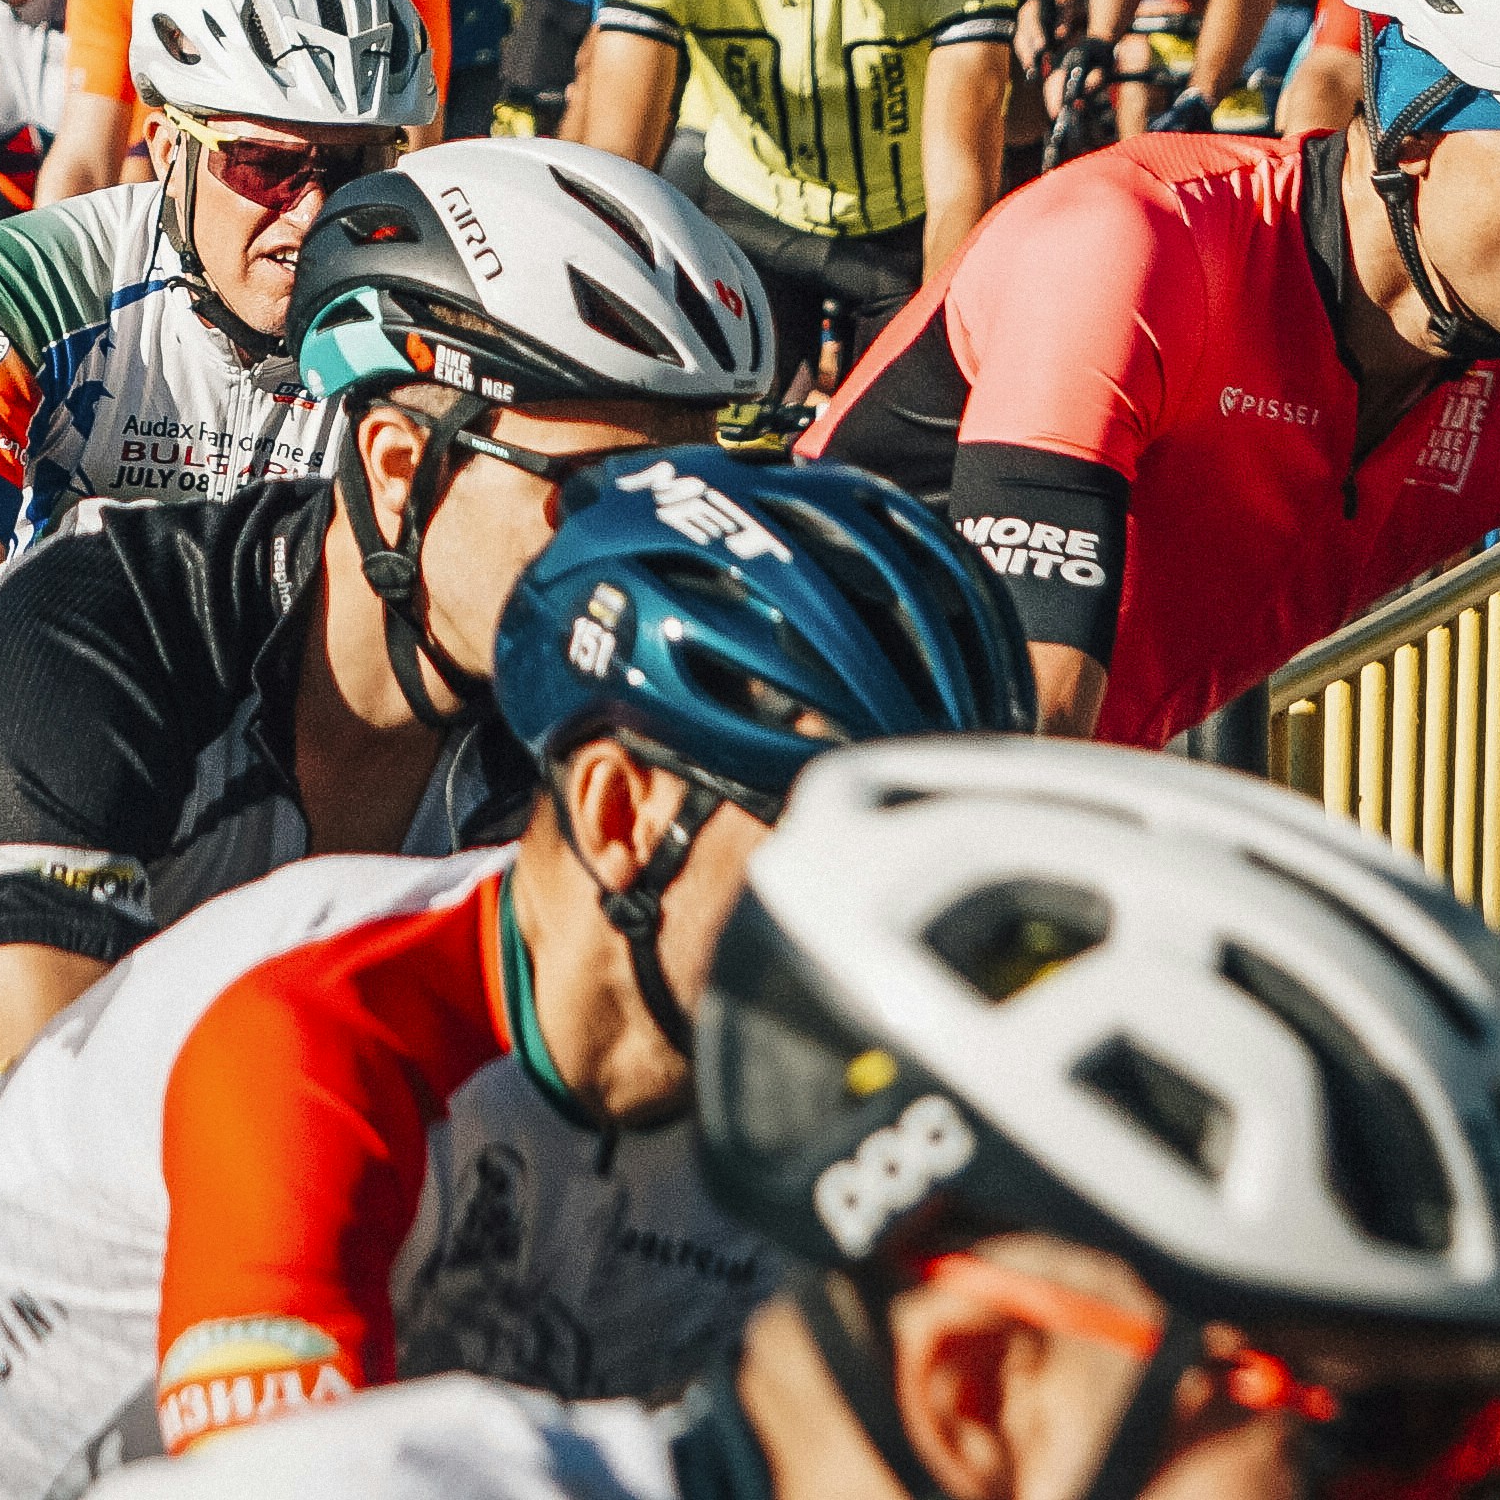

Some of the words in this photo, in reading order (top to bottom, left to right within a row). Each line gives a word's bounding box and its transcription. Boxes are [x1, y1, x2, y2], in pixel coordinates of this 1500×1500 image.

[440, 185, 503, 281] GIRO
[122, 414, 193, 440] Audax
[1238, 394, 1321, 426] PISSEI
[109, 465, 175, 490] JULY
[615, 460, 794, 565] MET
[815, 1094, 978, 1260] POC
